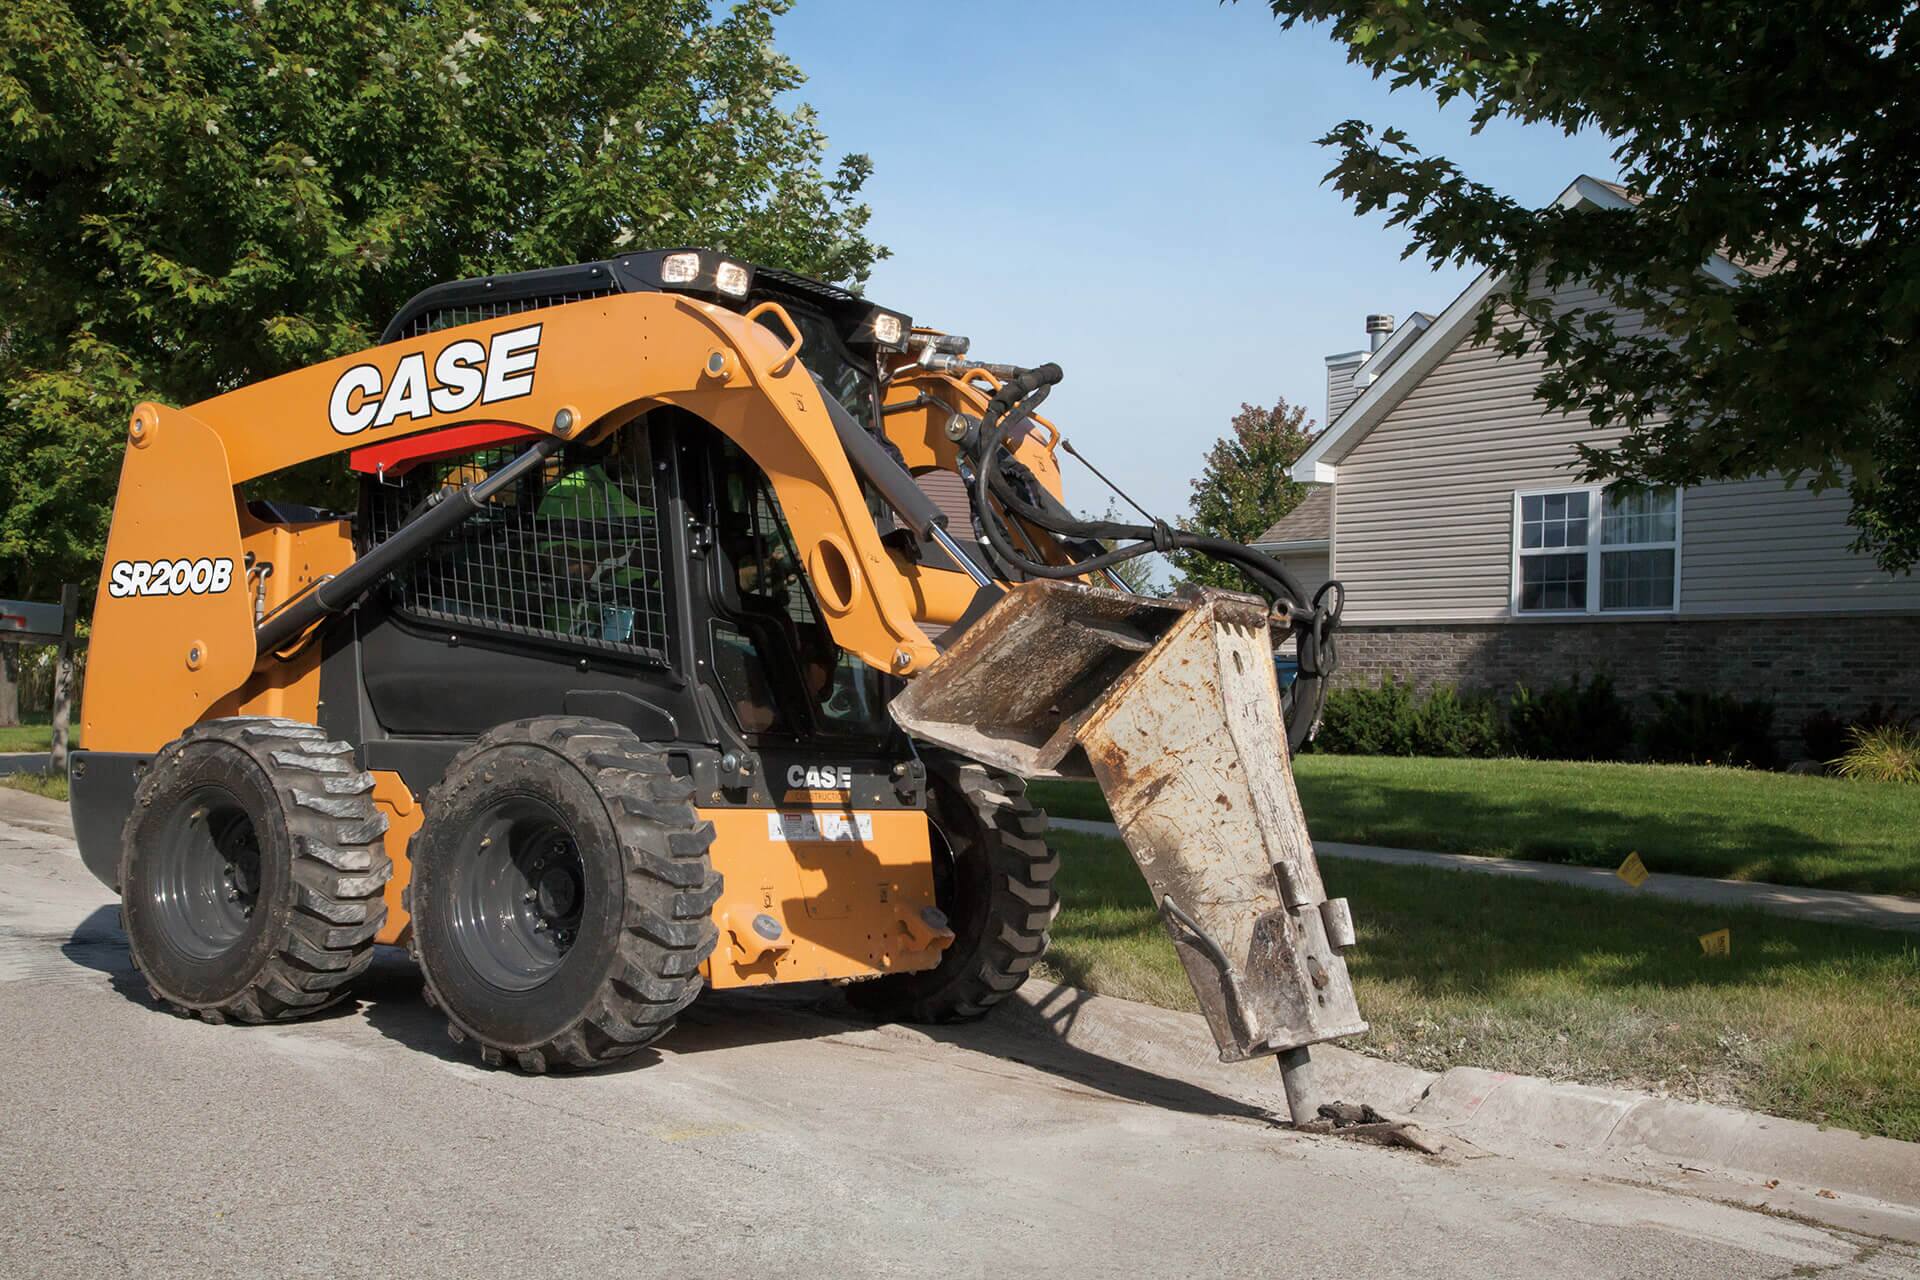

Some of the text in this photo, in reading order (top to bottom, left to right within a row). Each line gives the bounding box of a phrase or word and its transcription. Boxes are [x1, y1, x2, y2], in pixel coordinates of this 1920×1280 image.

[328, 322, 543, 435] CASE
[108, 557, 234, 598] SR200B
[787, 764, 851, 788] CASE
